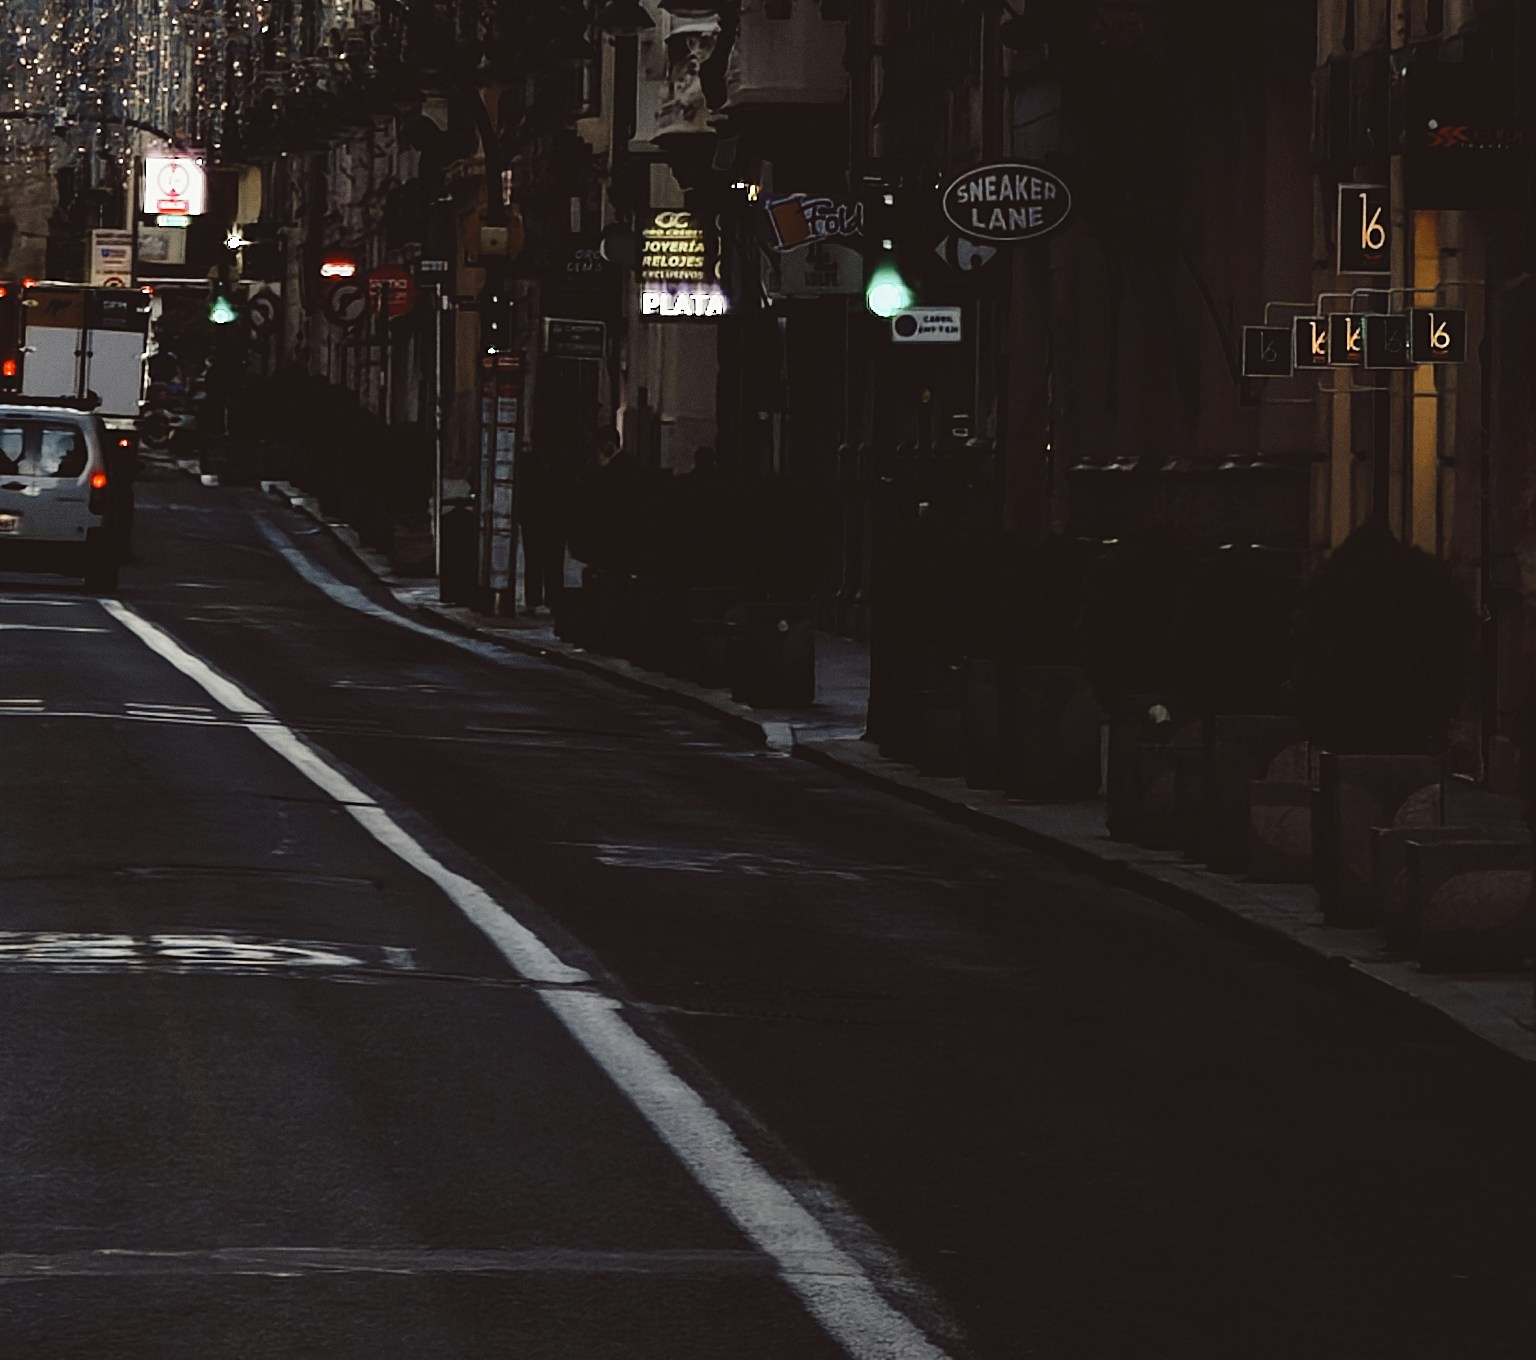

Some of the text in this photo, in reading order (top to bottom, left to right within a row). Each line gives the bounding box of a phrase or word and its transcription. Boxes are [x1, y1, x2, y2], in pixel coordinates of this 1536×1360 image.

[955, 173, 1058, 204] SNEAKER
[971, 206, 1044, 231] LANE
[1358, 192, 1386, 250] 16
[641, 238, 706, 253] JOYERÍA
[641, 255, 704, 268] RELOJES
[641, 292, 725, 317] PLATA
[1428, 312, 1451, 349] 16
